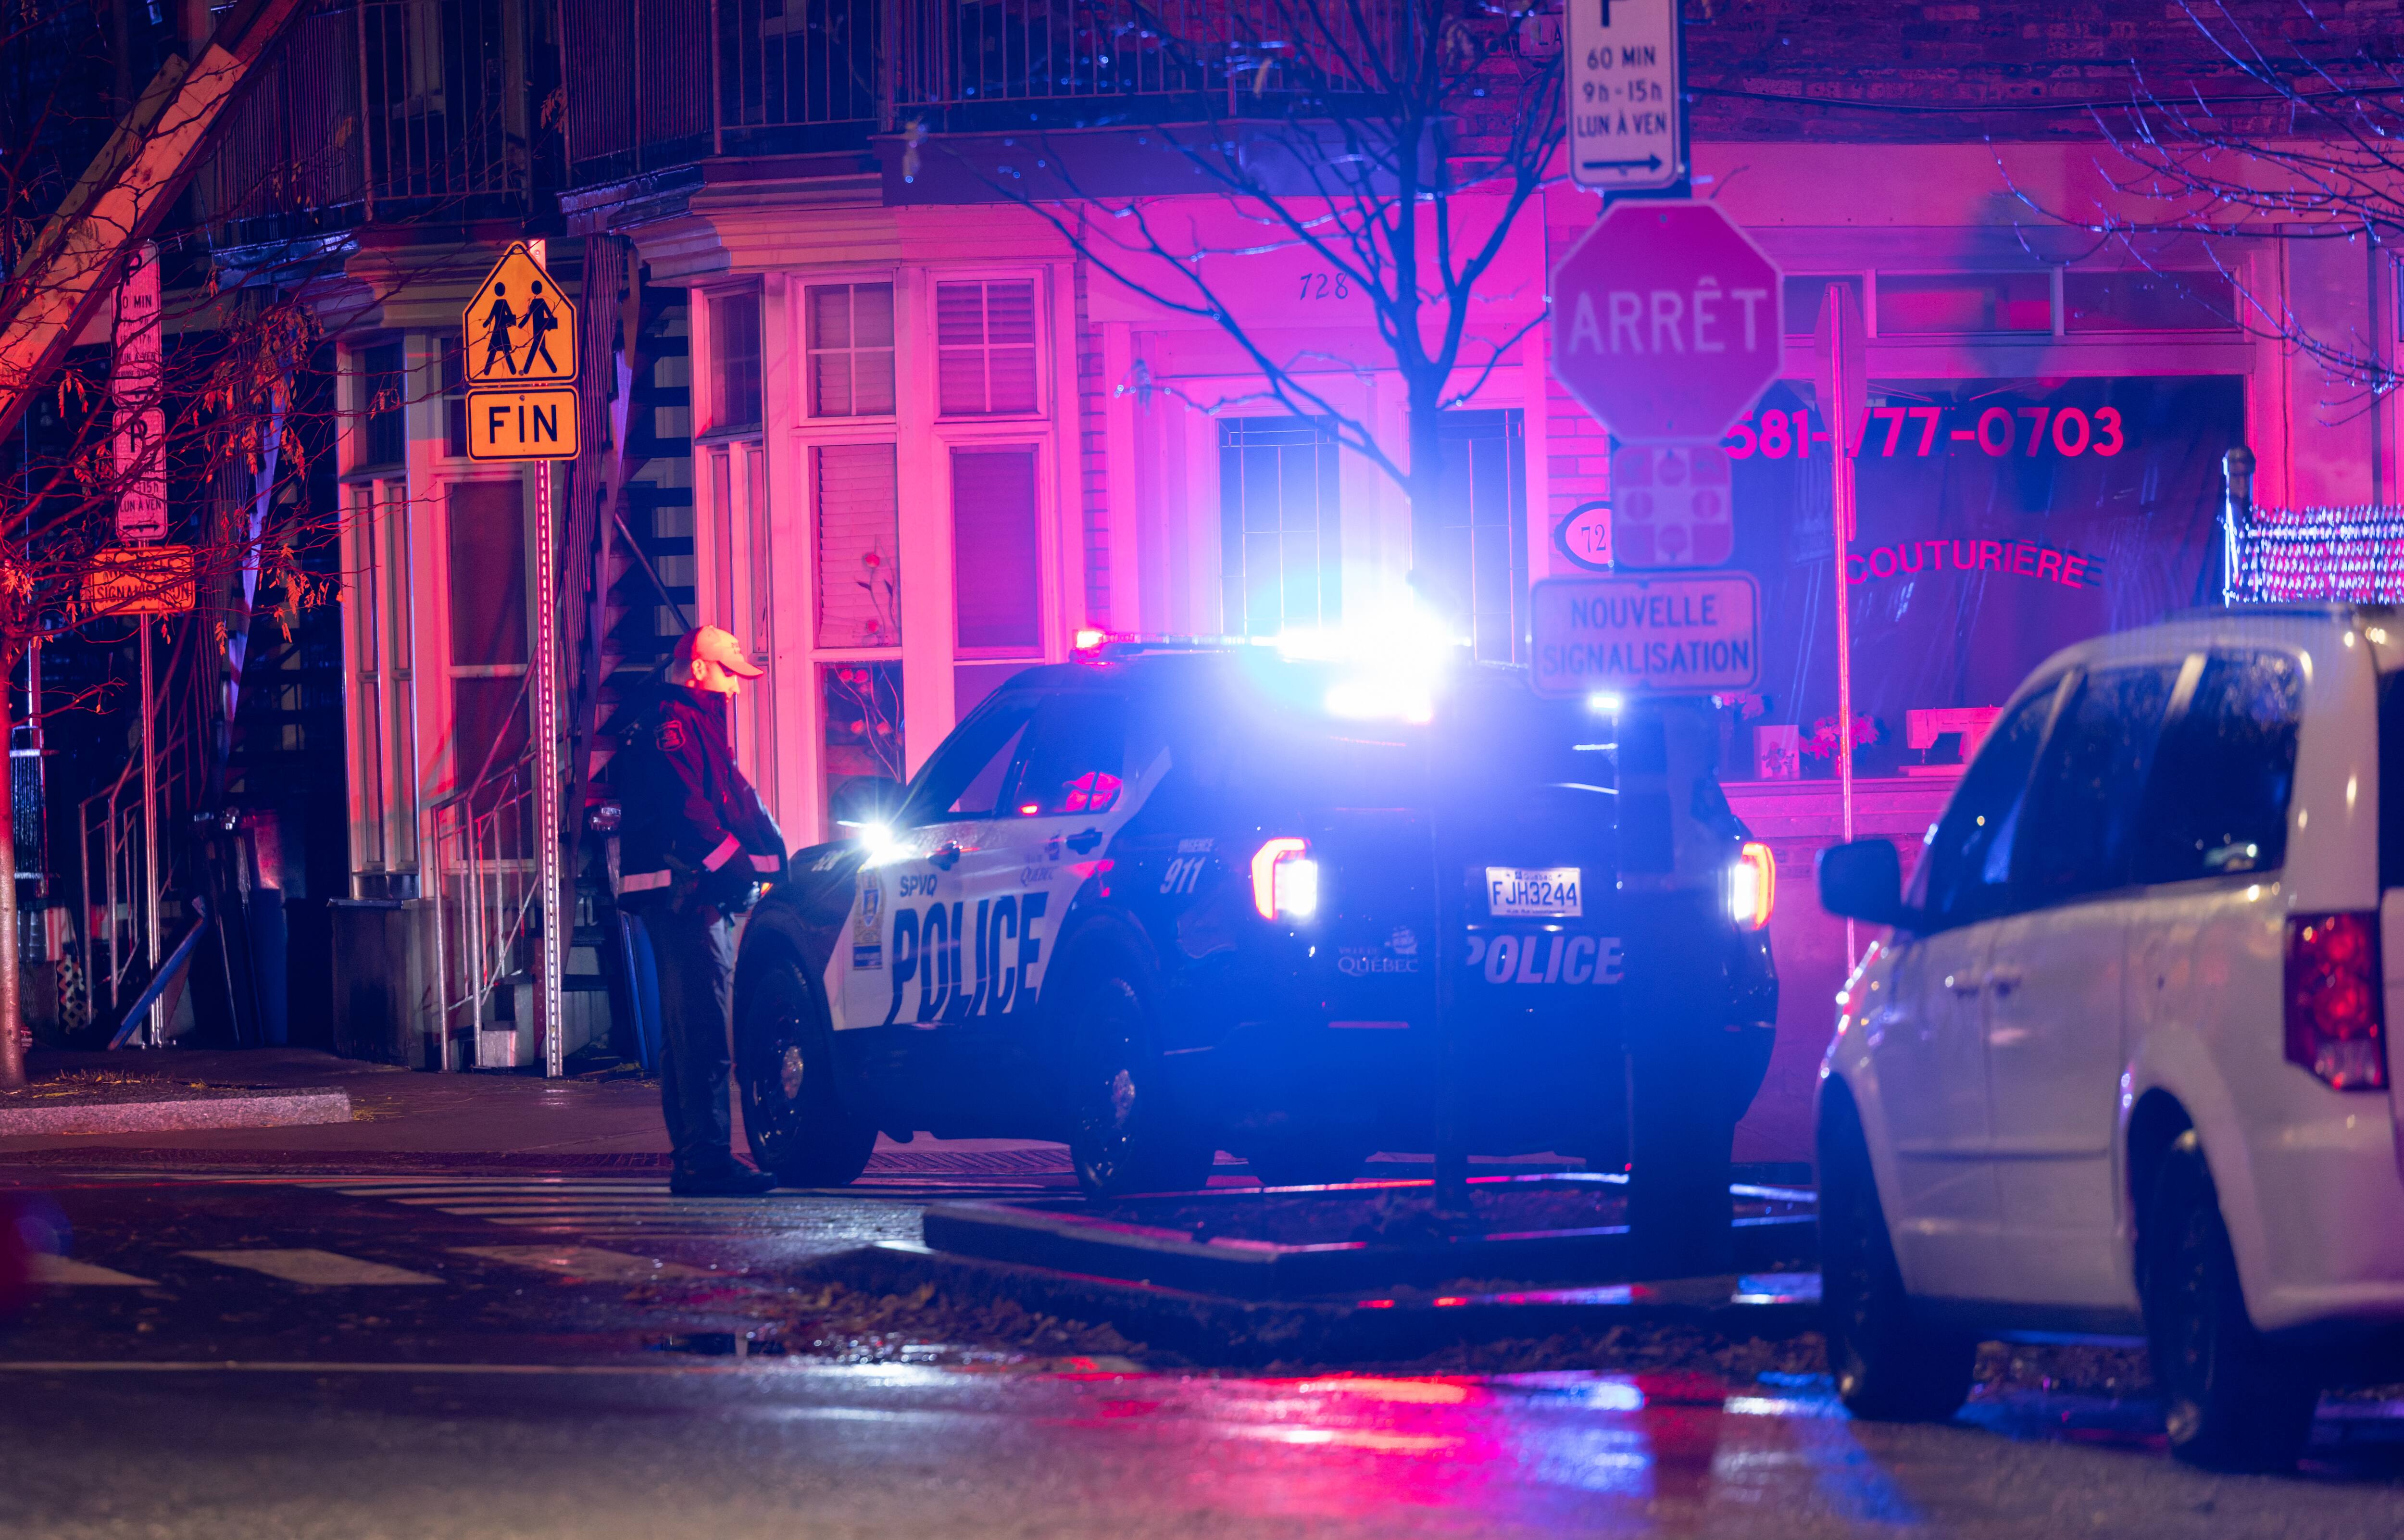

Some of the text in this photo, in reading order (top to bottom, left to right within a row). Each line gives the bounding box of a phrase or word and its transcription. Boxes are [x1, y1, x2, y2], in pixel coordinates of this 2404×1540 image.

[1587, 45, 1655, 70] 60 MIN
[1577, 114, 1610, 138] LUN
[1631, 111, 1667, 136] VEN
[1300, 272, 1349, 300] 728
[134, 295, 152, 308] MIN
[1567, 275, 1768, 354] ARRÊT
[131, 420, 148, 452] P
[488, 404, 558, 444] FIN
[120, 499, 135, 512] LUN
[145, 497, 162, 511] VEN
[1581, 524, 1606, 553] 72
[1846, 538, 2089, 589] COUTURIÈRE
[1570, 594, 1717, 629] NOUVELLE
[1542, 639, 1749, 676] SIGNALISATION
[899, 874, 938, 898] SPVQ
[1159, 856, 1206, 894] 911
[1492, 881, 1578, 906] FJH3244
[883, 891, 1050, 1025] POLICE
[1338, 955, 1418, 977] QUÉBEC
